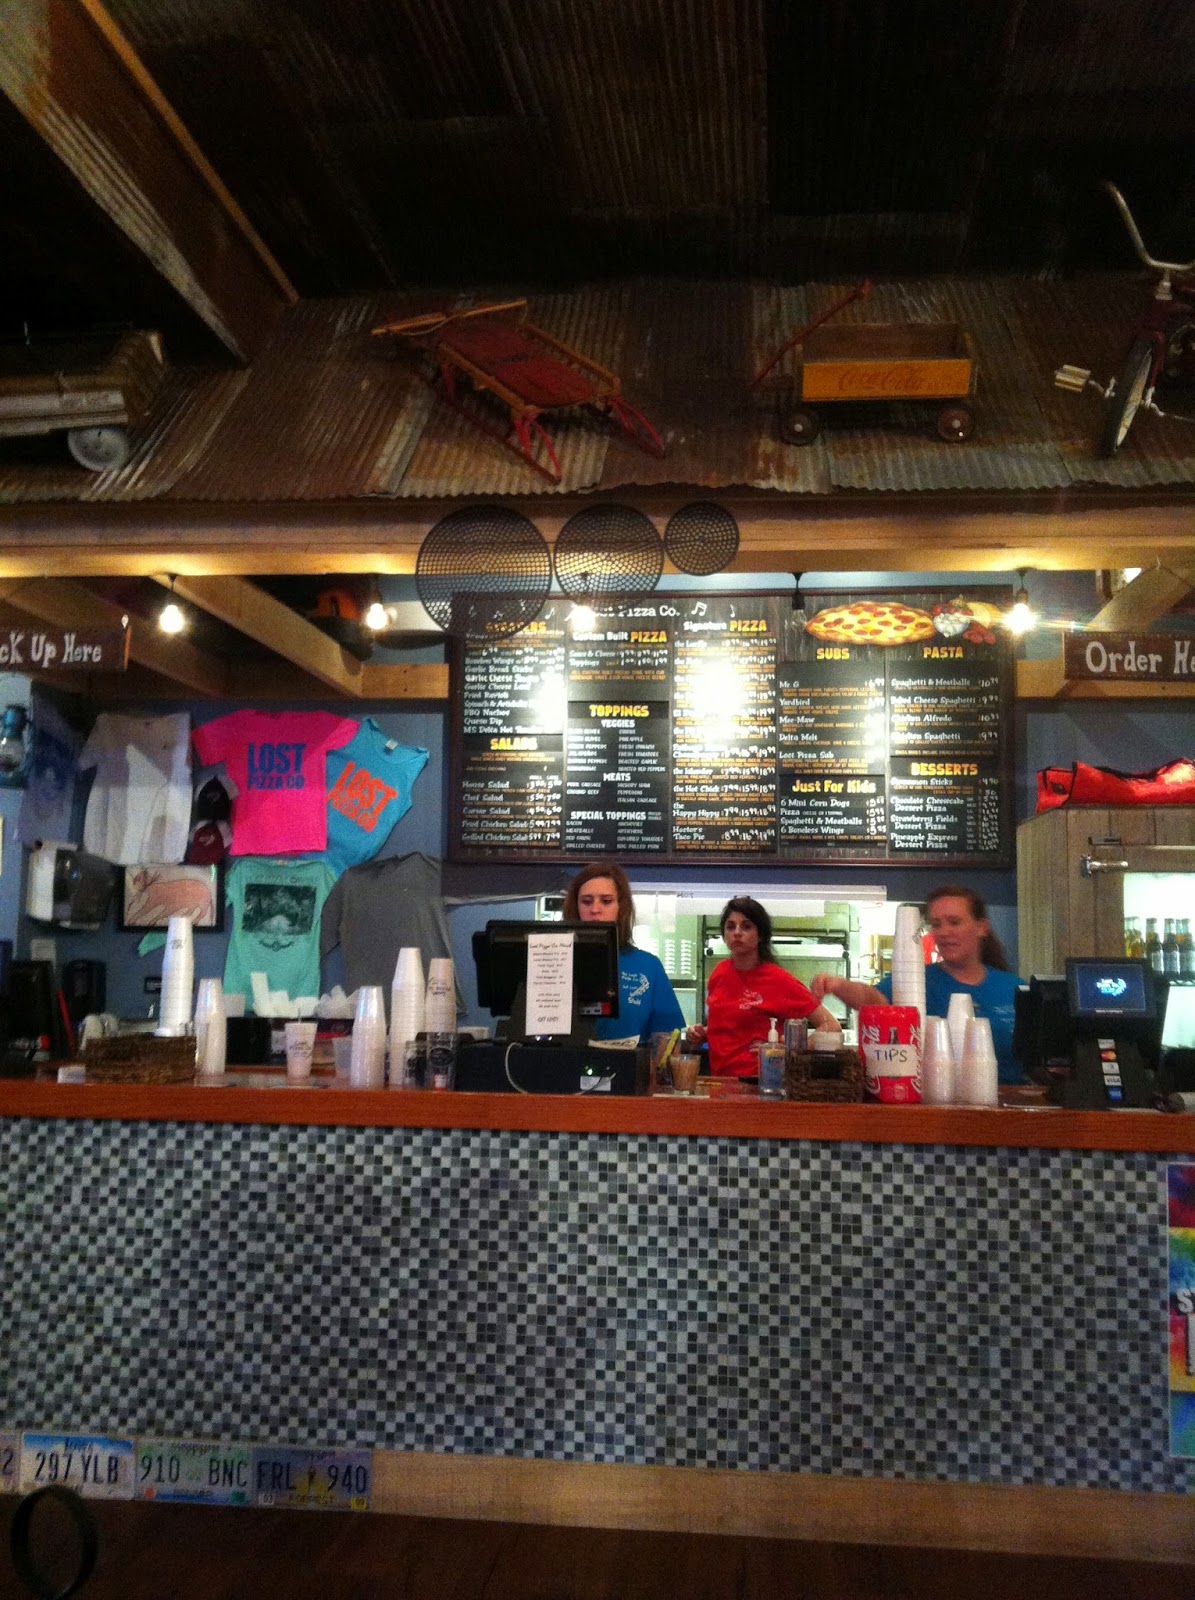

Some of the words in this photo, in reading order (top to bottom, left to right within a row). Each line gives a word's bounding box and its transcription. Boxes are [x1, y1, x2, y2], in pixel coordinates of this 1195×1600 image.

[659, 605, 680, 617] Co.
[683, 621, 728, 632] Signature
[729, 620, 767, 632] PIZZA
[606, 631, 629, 641] Built
[630, 631, 668, 643] PIZZA
[30, 633, 57, 668] Up
[62, 632, 102, 663] Here
[816, 648, 850, 660] SUBS
[923, 646, 964, 659] PASTA
[1085, 641, 1163, 673] Order
[488, 674, 513, 682] Cheese
[891, 678, 926, 687] Spaghetti
[935, 678, 970, 686] Meatballs
[779, 698, 811, 706] Yardbird
[913, 696, 938, 704] Cheese
[939, 696, 976, 705] Spaghetti
[589, 704, 650, 718] TOPPINGS
[922, 714, 953, 722] Alfredo
[600, 719, 636, 728] VEGGIES
[779, 733, 799, 741] Delta
[801, 733, 818, 741] Melt
[924, 732, 961, 740] Spaghetti
[490, 737, 538, 751] SALADS
[247, 743, 306, 774] LOST
[819, 751, 834, 759] Sub
[911, 762, 978, 776] DESSERTS
[603, 772, 631, 781] MEATS
[247, 774, 285, 790] PIZZA
[286, 775, 305, 789] CO
[487, 780, 510, 788] Salad
[328, 760, 399, 818] LOST
[700, 784, 720, 792] Chick
[792, 780, 821, 793] Just
[823, 780, 844, 793] For
[846, 780, 877, 794] Kids
[482, 793, 504, 802] Salad
[926, 796, 964, 804] Cheesecake
[788, 799, 806, 807] Mini
[809, 799, 828, 807] Corn
[830, 799, 850, 808] Dogs
[894, 804, 923, 812] Dessert
[925, 804, 947, 812] Pizza
[488, 806, 511, 814] Salad
[697, 809, 720, 818] Hippy
[570, 811, 604, 820] SPECIAL
[605, 811, 647, 821] TOPPINGS
[890, 814, 933, 823] Strawberry
[935, 814, 958, 822] Fields
[780, 817, 814, 826] Spaghetti
[824, 817, 863, 825] Meatballs
[894, 822, 922, 830] Dessert
[925, 821, 946, 830] Pizza
[788, 826, 818, 834] Boneless
[820, 826, 845, 835] Wings
[890, 832, 925, 842] Pineapple
[927, 833, 958, 842] Express
[894, 840, 923, 848] Dessert
[926, 840, 948, 849] Pizza
[874, 1049, 908, 1063] TIPS
[81, 1453, 119, 1485] YLB
[140, 1455, 180, 1483] 910
[208, 1457, 247, 1487] BNC
[256, 1461, 296, 1490] FRL
[328, 1464, 366, 1493] 940
